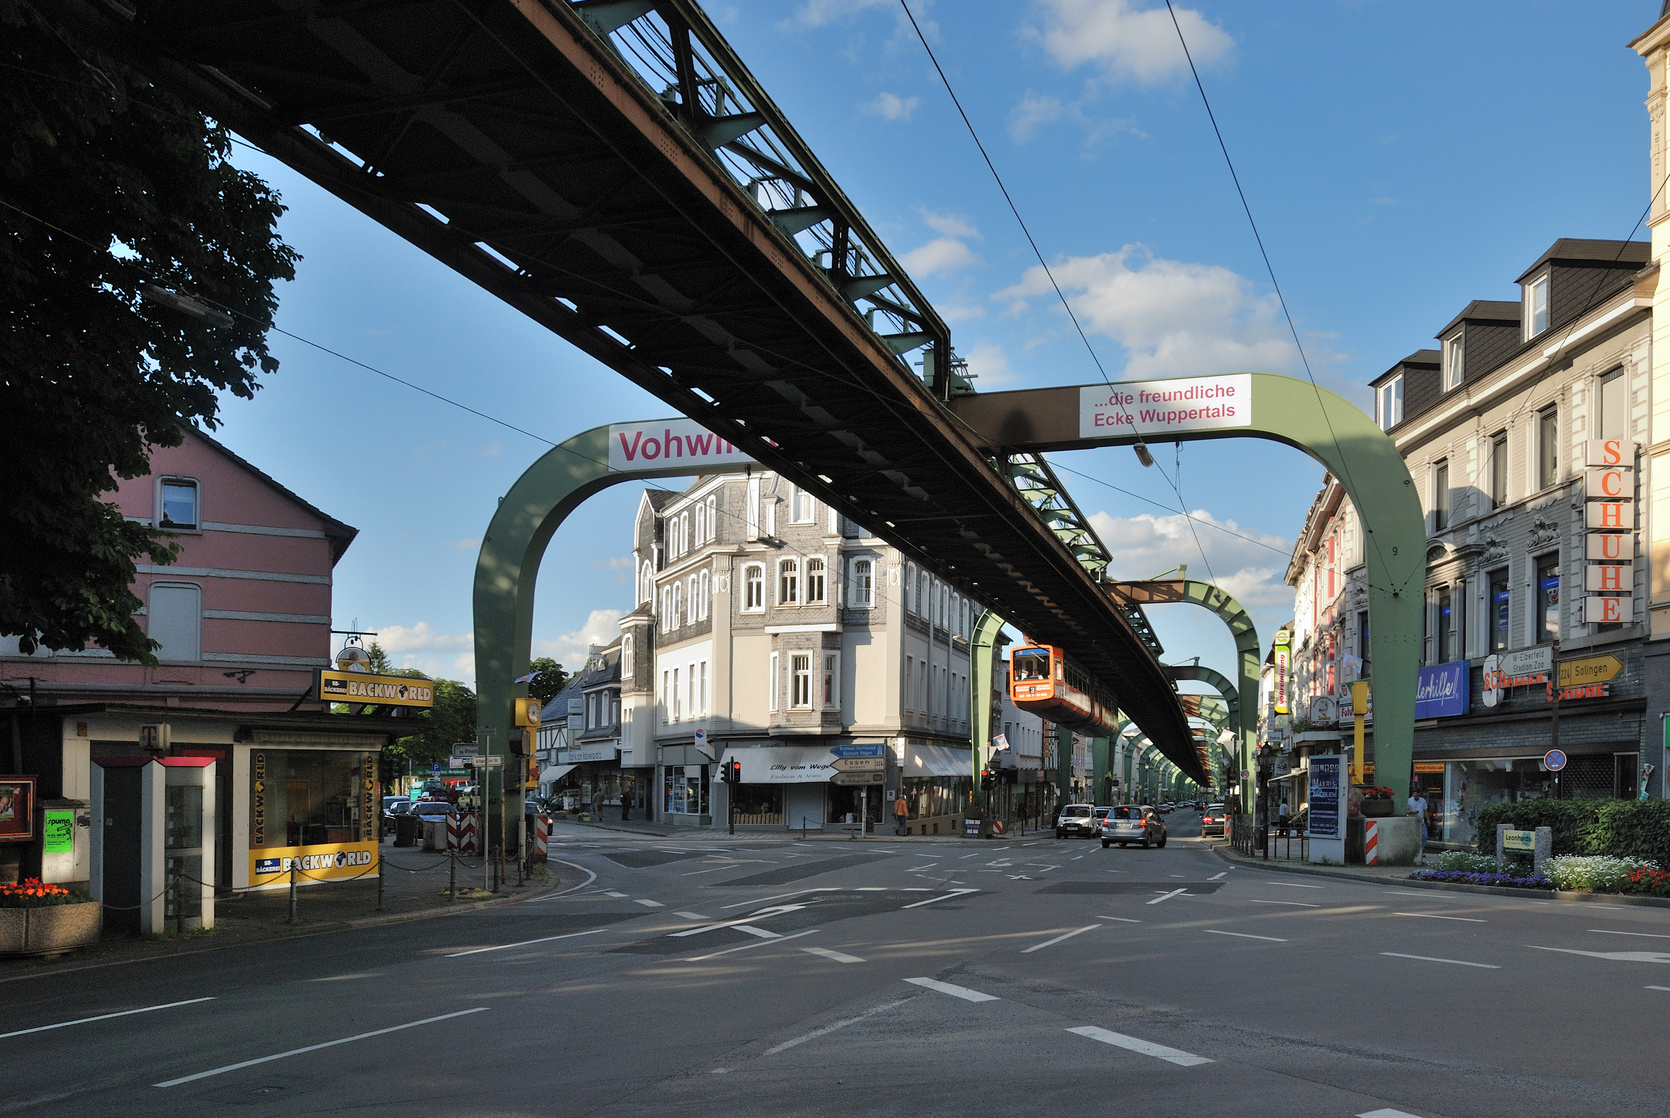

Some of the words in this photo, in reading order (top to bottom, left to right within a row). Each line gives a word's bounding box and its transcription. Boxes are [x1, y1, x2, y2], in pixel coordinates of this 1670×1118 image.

[1139, 384, 1236, 404] freundliche
[1094, 411, 1135, 427] Ecke
[1139, 403, 1236, 424] Wuppertals
[1599, 440, 1624, 622] SCHUHE
[1392, 546, 1398, 556] 9
[1513, 663, 1532, 672] Stadion
[1534, 661, 1545, 669] Zoo
[1560, 668, 1570, 680] 224
[1575, 664, 1608, 677] Solingen
[349, 681, 432, 701] BACKWORLD
[142, 726, 157, 747] T
[256, 753, 265, 845] BACKWORLD
[365, 755, 373, 837] BACKWORLD
[281, 851, 372, 872] BACKWORLD
